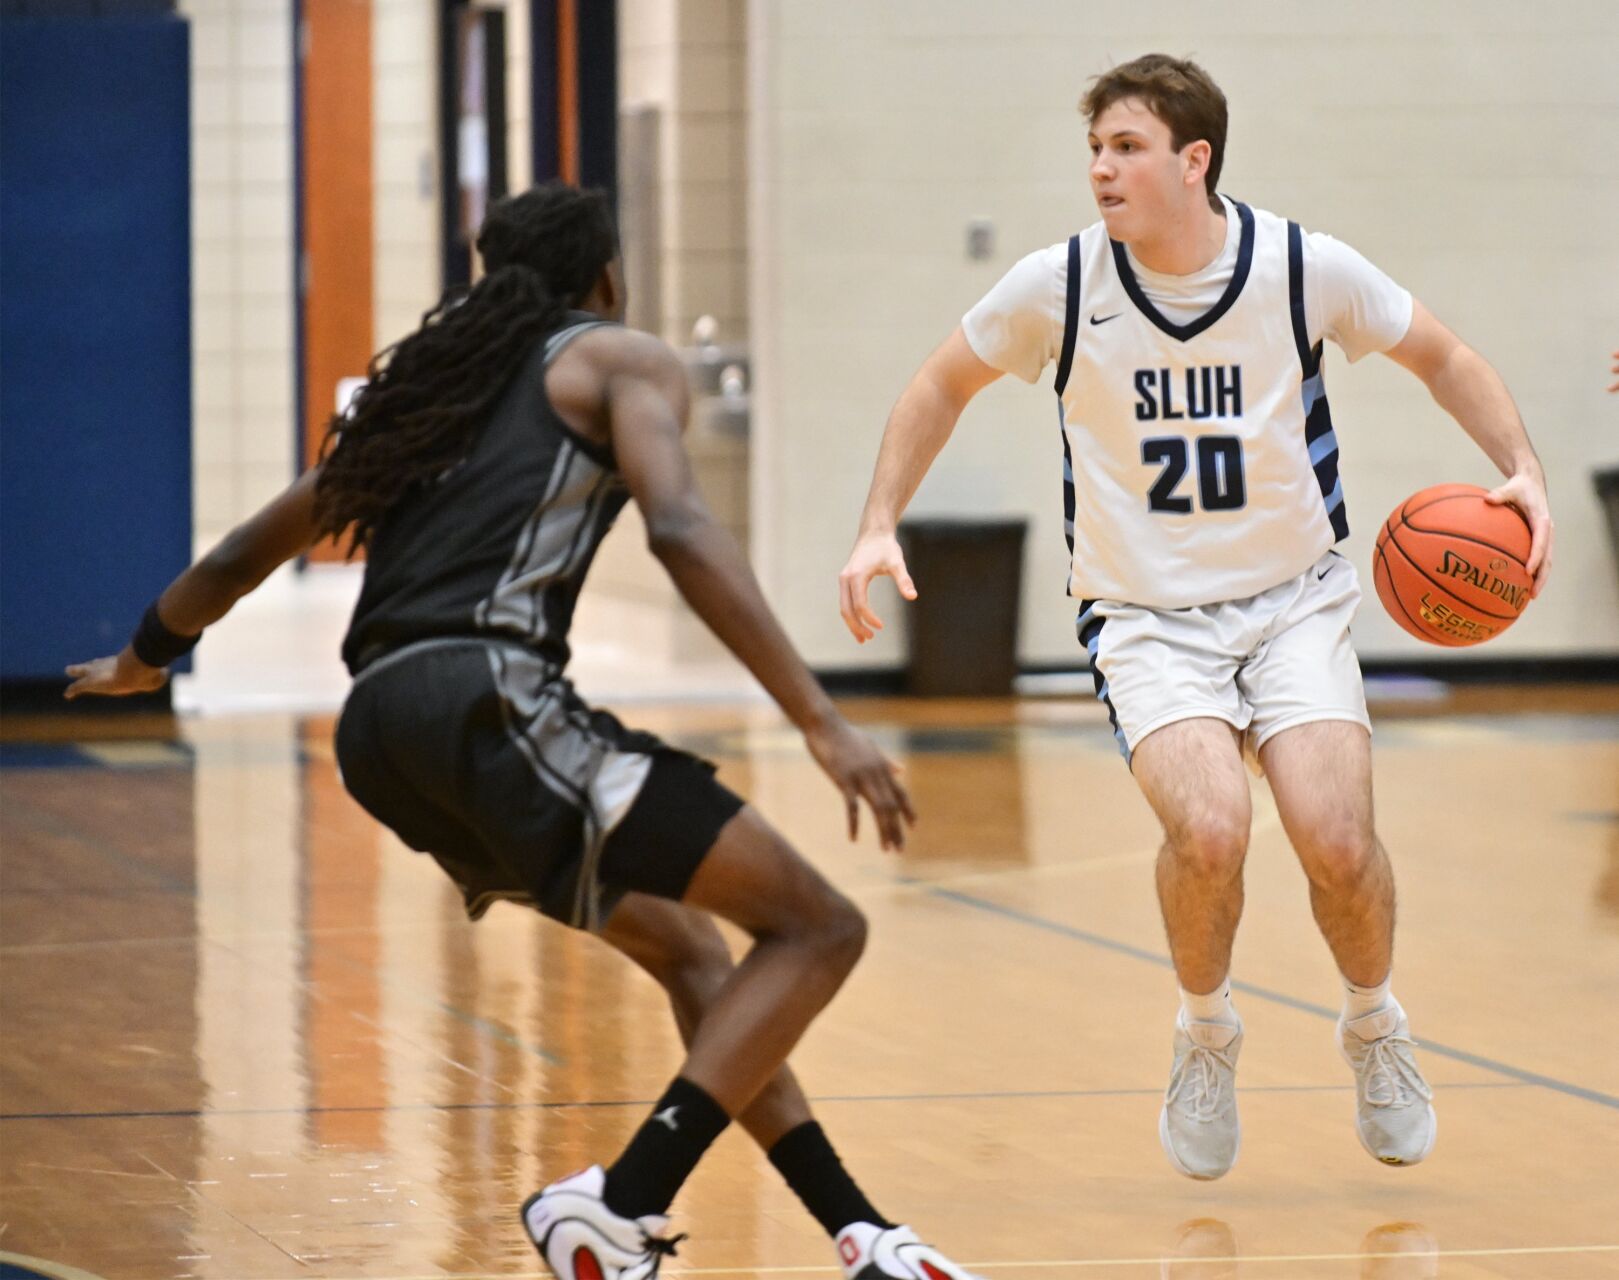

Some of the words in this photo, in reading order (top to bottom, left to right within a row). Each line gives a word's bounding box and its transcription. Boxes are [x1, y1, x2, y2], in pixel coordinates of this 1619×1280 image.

[1134, 365, 1243, 421] SLUH
[1140, 434, 1248, 515] 20
[1435, 549, 1529, 611] SPALDING
